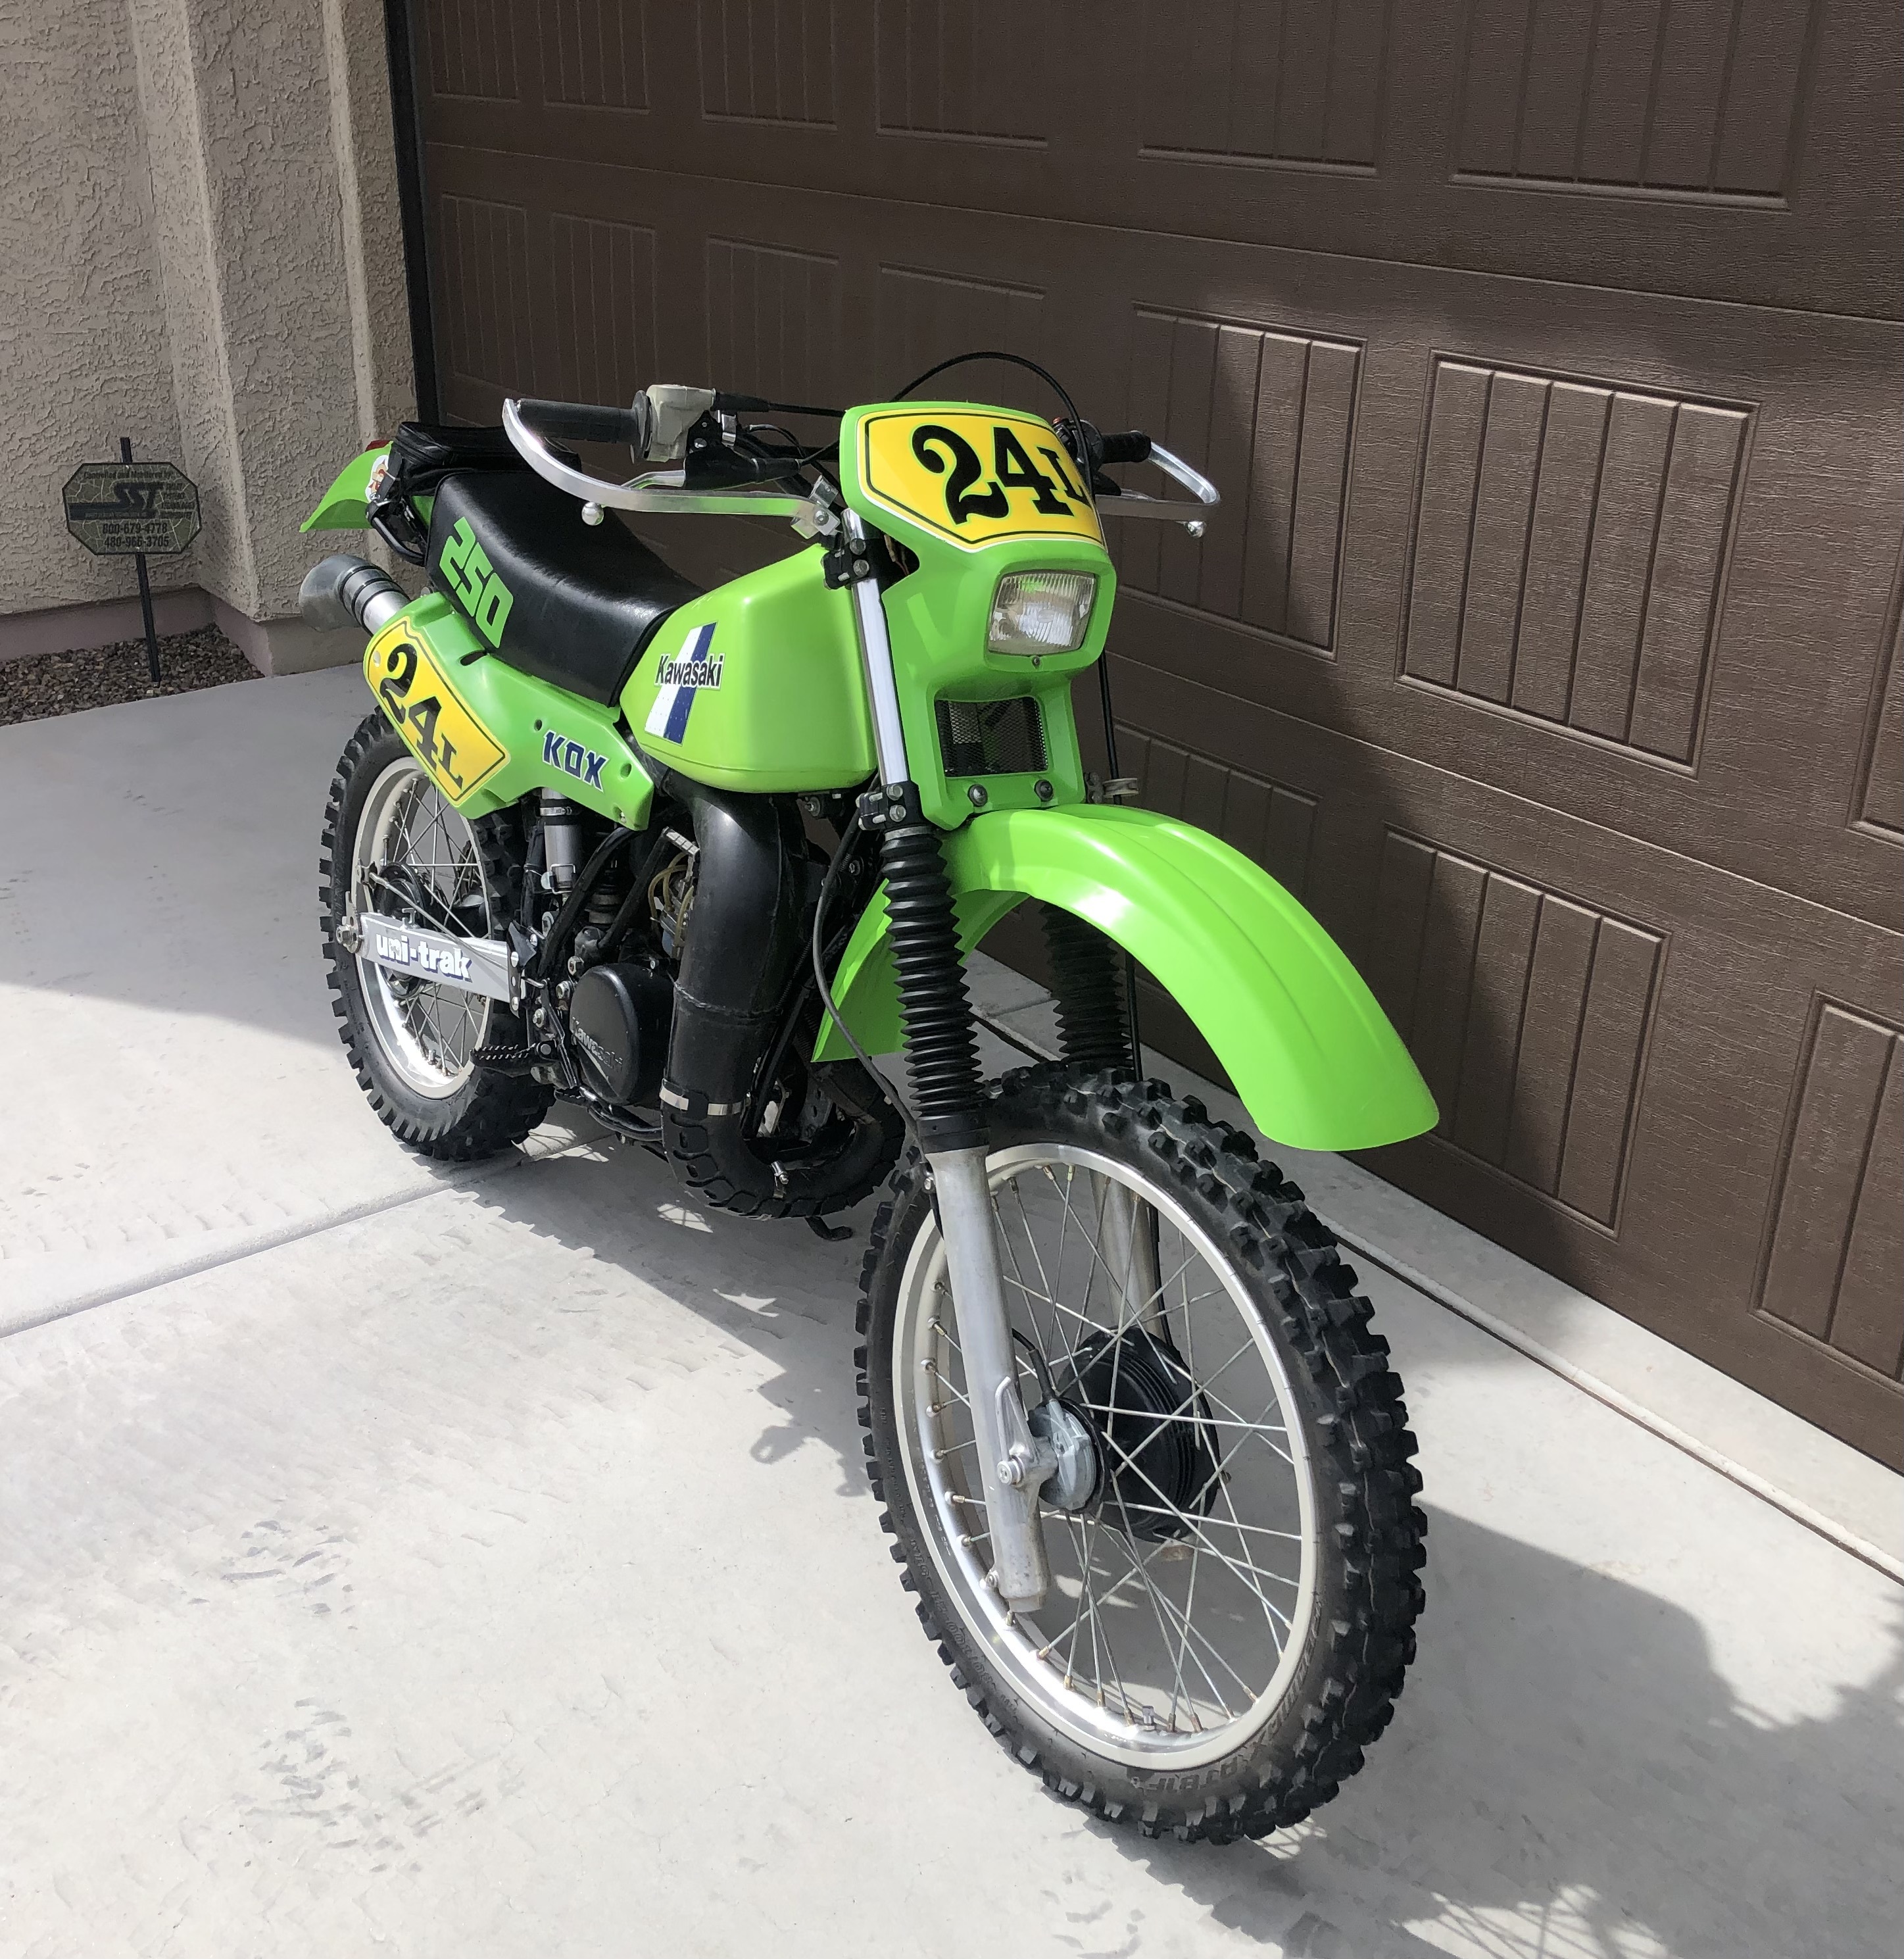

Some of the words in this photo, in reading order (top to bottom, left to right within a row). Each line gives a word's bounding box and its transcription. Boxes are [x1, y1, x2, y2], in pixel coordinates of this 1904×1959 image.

[103, 522, 167, 535] 800-679-4778
[439, 516, 514, 649] 250
[655, 655, 724, 687] Kawasaki
[543, 730, 608, 792] KDX
[376, 933, 472, 983] uni-trak
